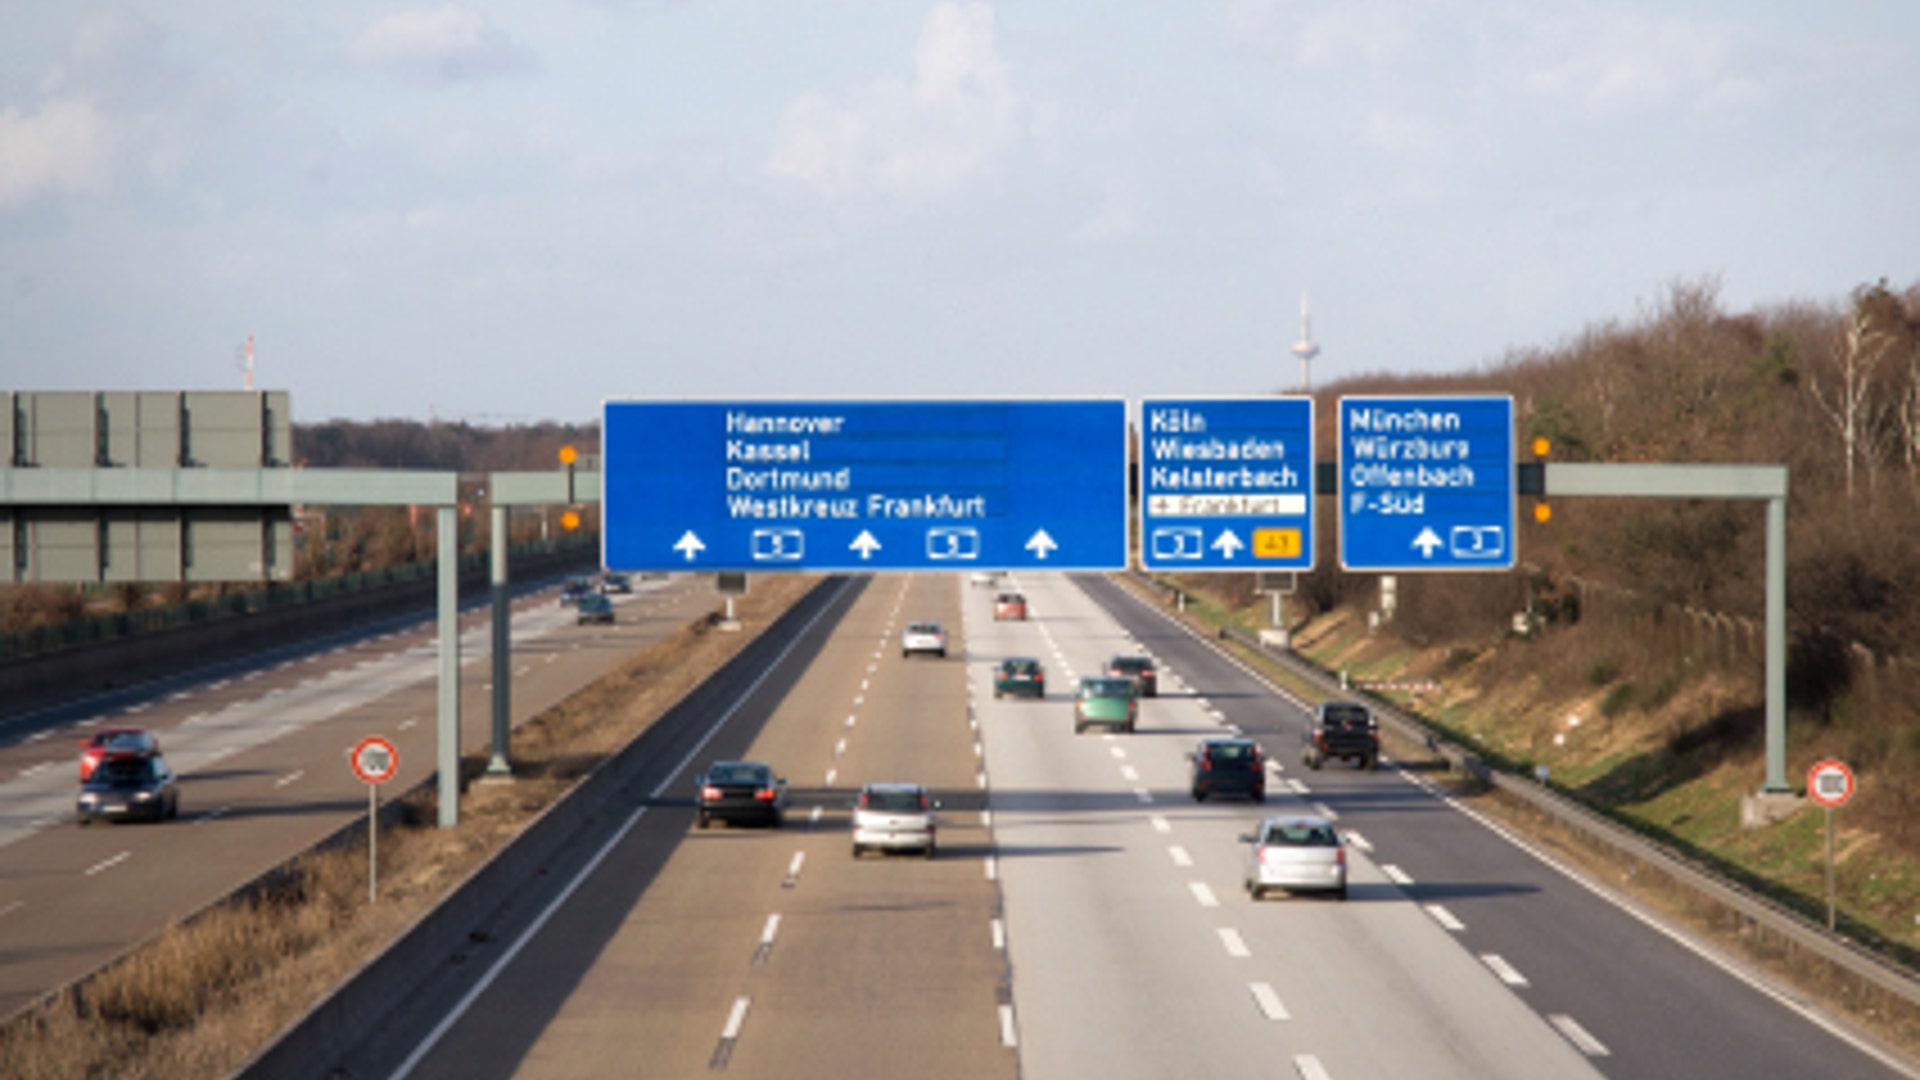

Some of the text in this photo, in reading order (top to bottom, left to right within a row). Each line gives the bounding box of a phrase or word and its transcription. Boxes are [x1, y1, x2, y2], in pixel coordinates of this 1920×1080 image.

[726, 411, 845, 433] Hannover
[726, 439, 811, 461] Kassel
[726, 467, 850, 490] Dortmund
[727, 494, 985, 518] Westkreuz Frankfurt
